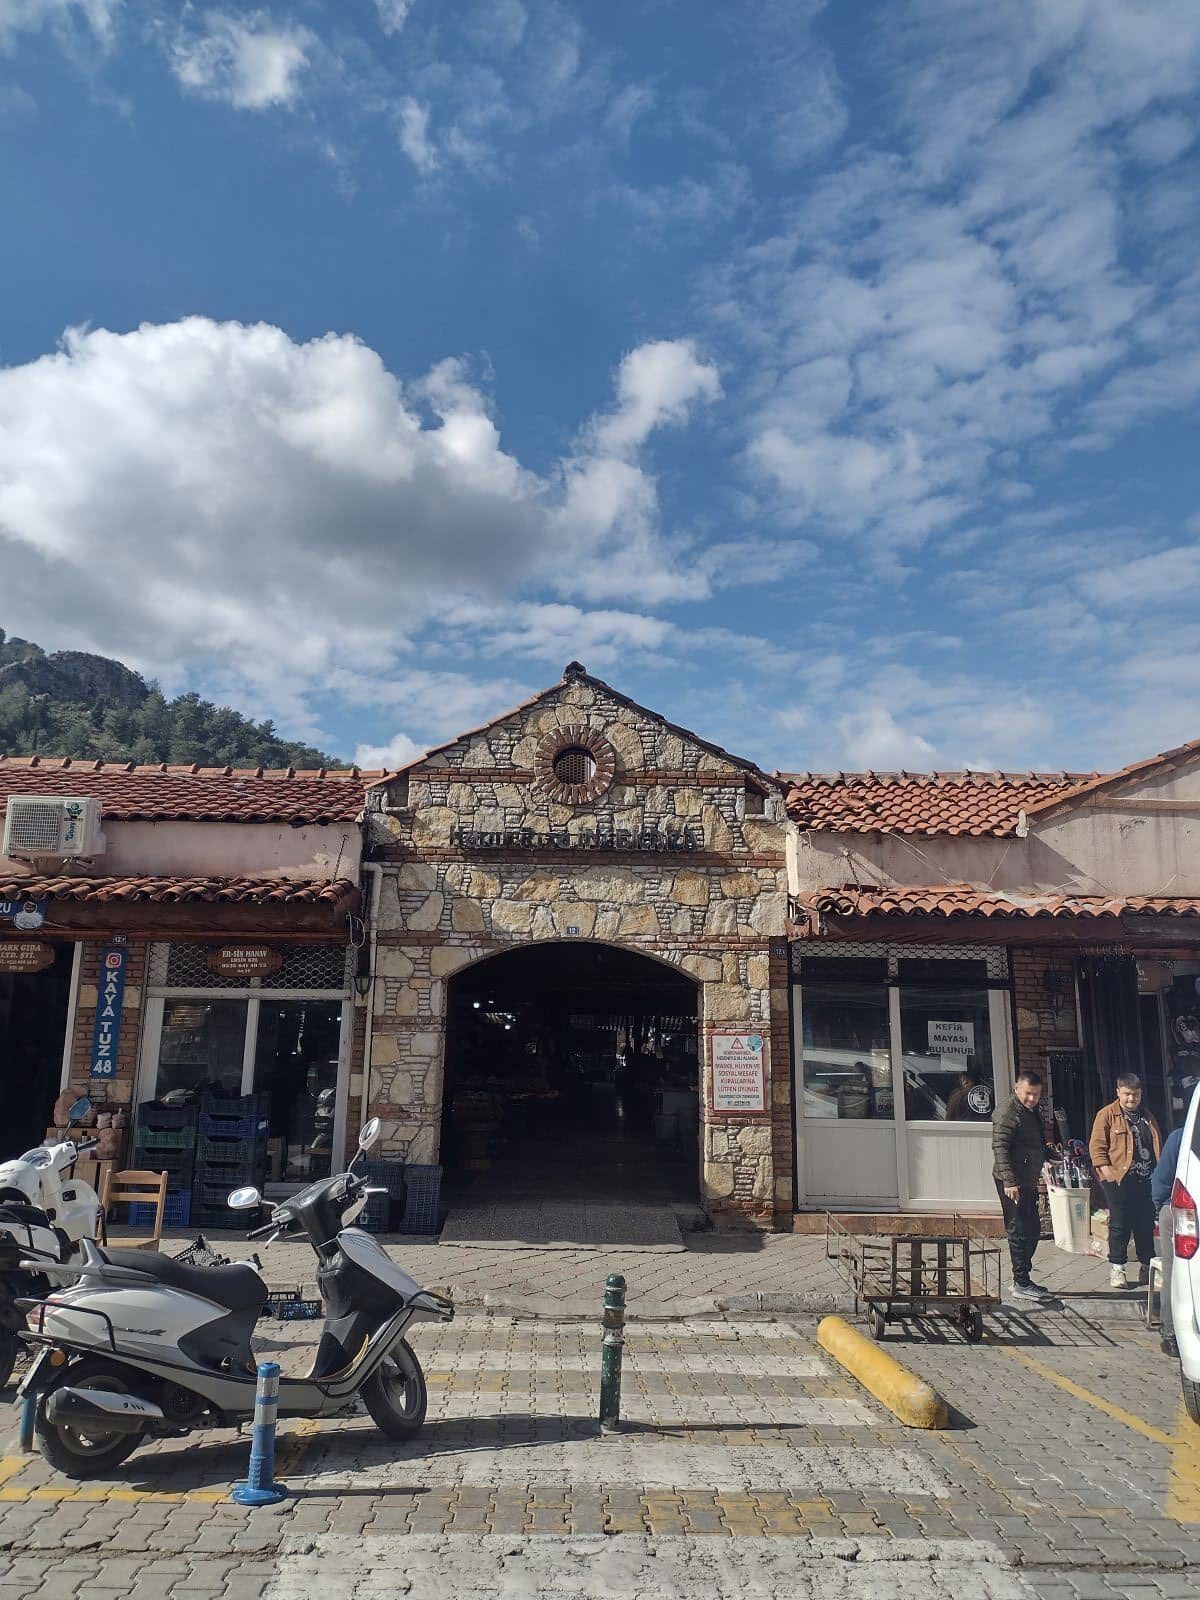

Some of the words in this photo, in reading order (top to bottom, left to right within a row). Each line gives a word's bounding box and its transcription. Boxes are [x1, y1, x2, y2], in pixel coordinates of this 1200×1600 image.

[1, 951, 18, 959] LTD.
[246, 950, 267, 958] MANAV
[101, 971, 119, 1017] KAYA
[935, 1023, 962, 1031] KEFİR
[97, 1021, 113, 1056] TUZ
[933, 1034, 968, 1043] MAYASI
[928, 1046, 975, 1056] BULUNUR
[93, 1059, 112, 1074] 48
